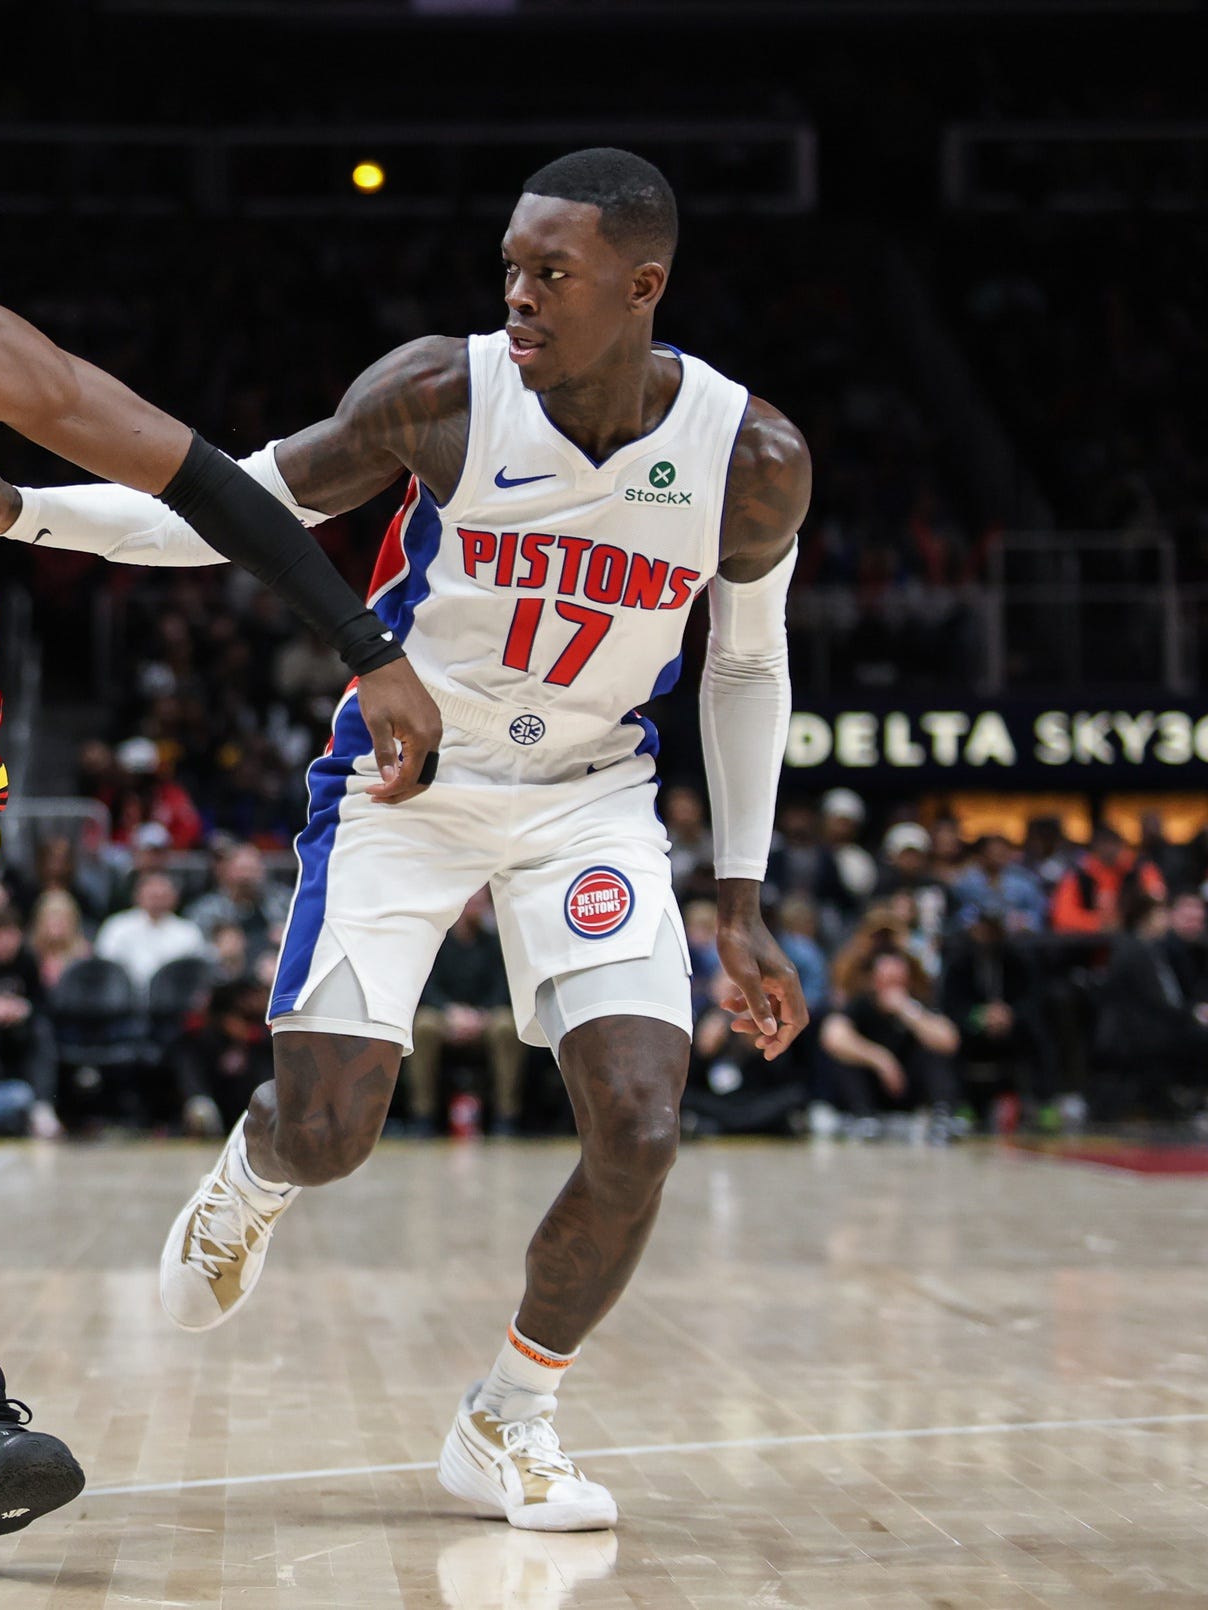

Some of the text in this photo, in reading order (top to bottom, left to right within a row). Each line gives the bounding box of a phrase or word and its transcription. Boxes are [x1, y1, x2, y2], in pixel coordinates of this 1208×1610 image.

[624, 488, 692, 506] StockX
[456, 527, 701, 611] PISTONS
[502, 597, 614, 688] 17
[783, 711, 1017, 767] DELTA
[577, 888, 619, 906] DETROIT
[577, 900, 620, 917] PISTONS
